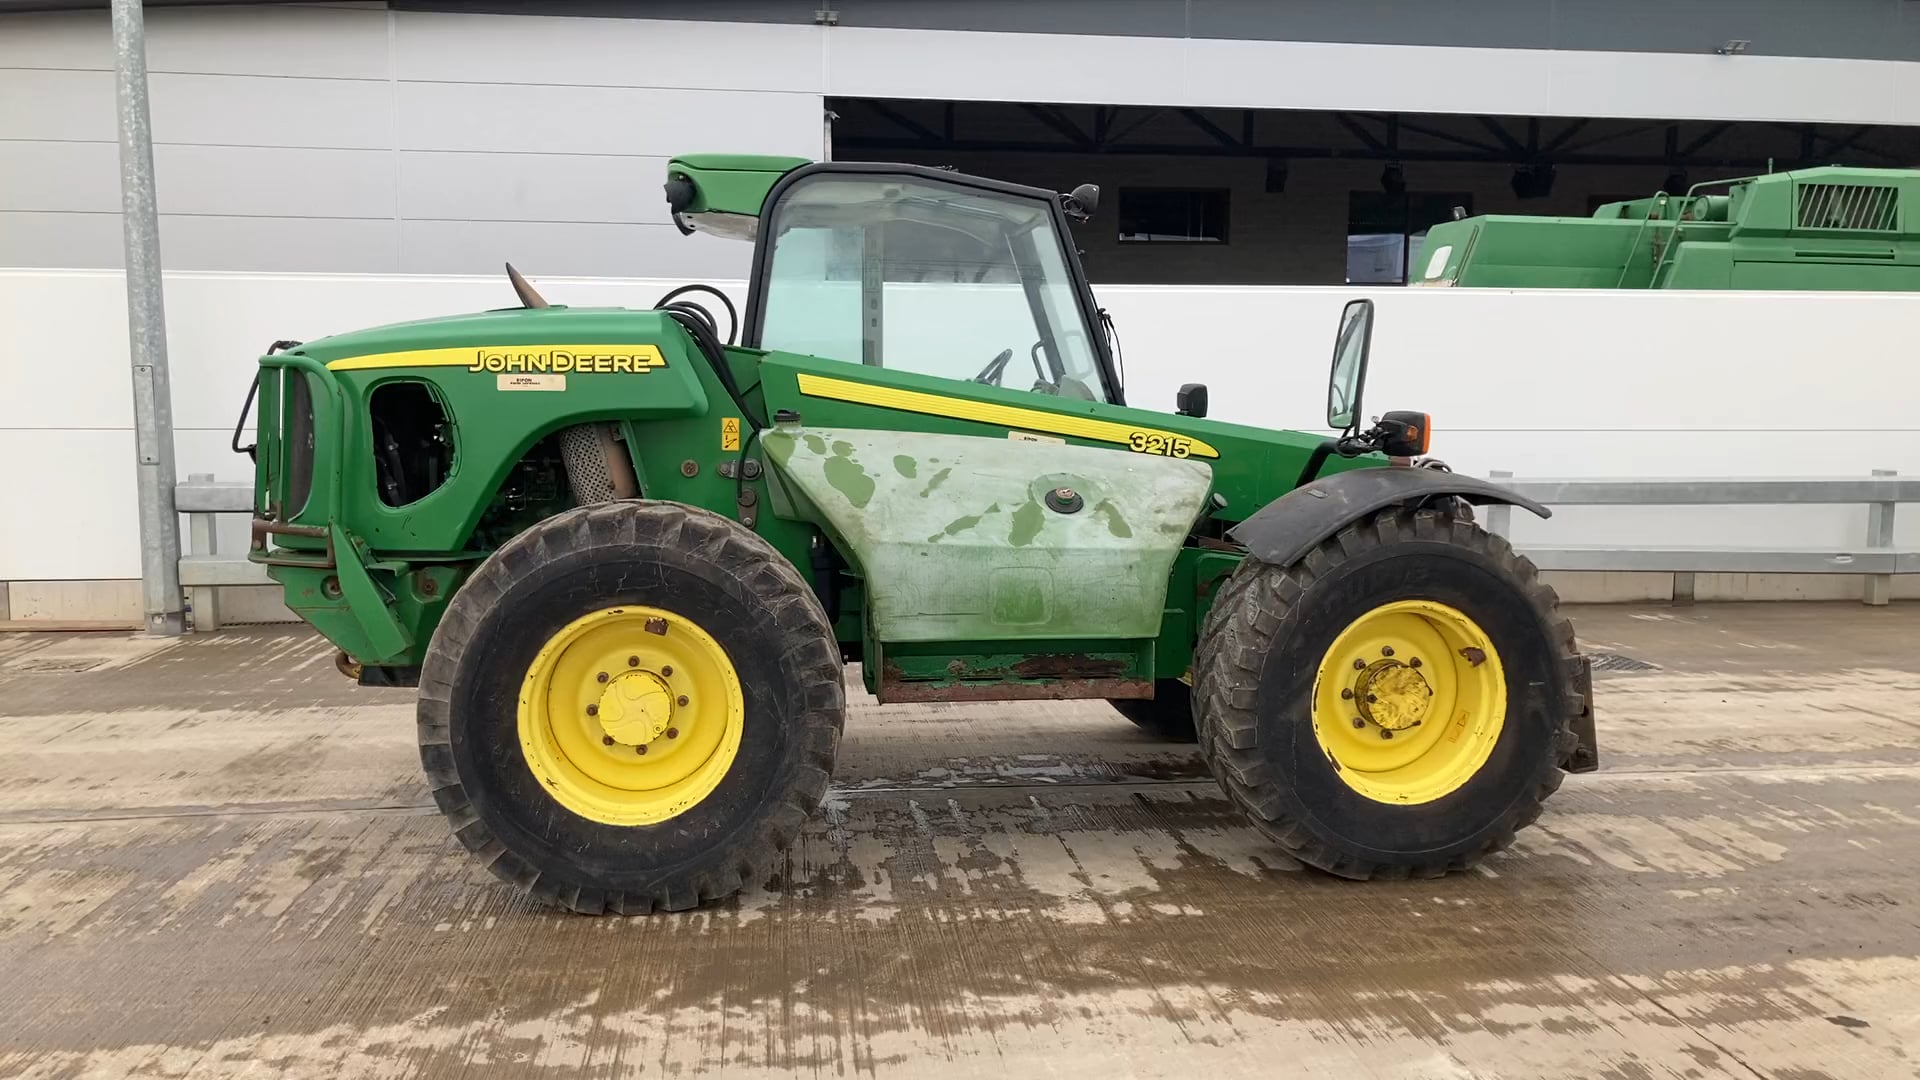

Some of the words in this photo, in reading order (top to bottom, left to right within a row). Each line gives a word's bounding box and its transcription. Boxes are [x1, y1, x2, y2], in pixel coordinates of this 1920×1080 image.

[468, 350, 547, 373] JOHN
[551, 350, 652, 373] DEERE
[1128, 431, 1192, 460] 3215
